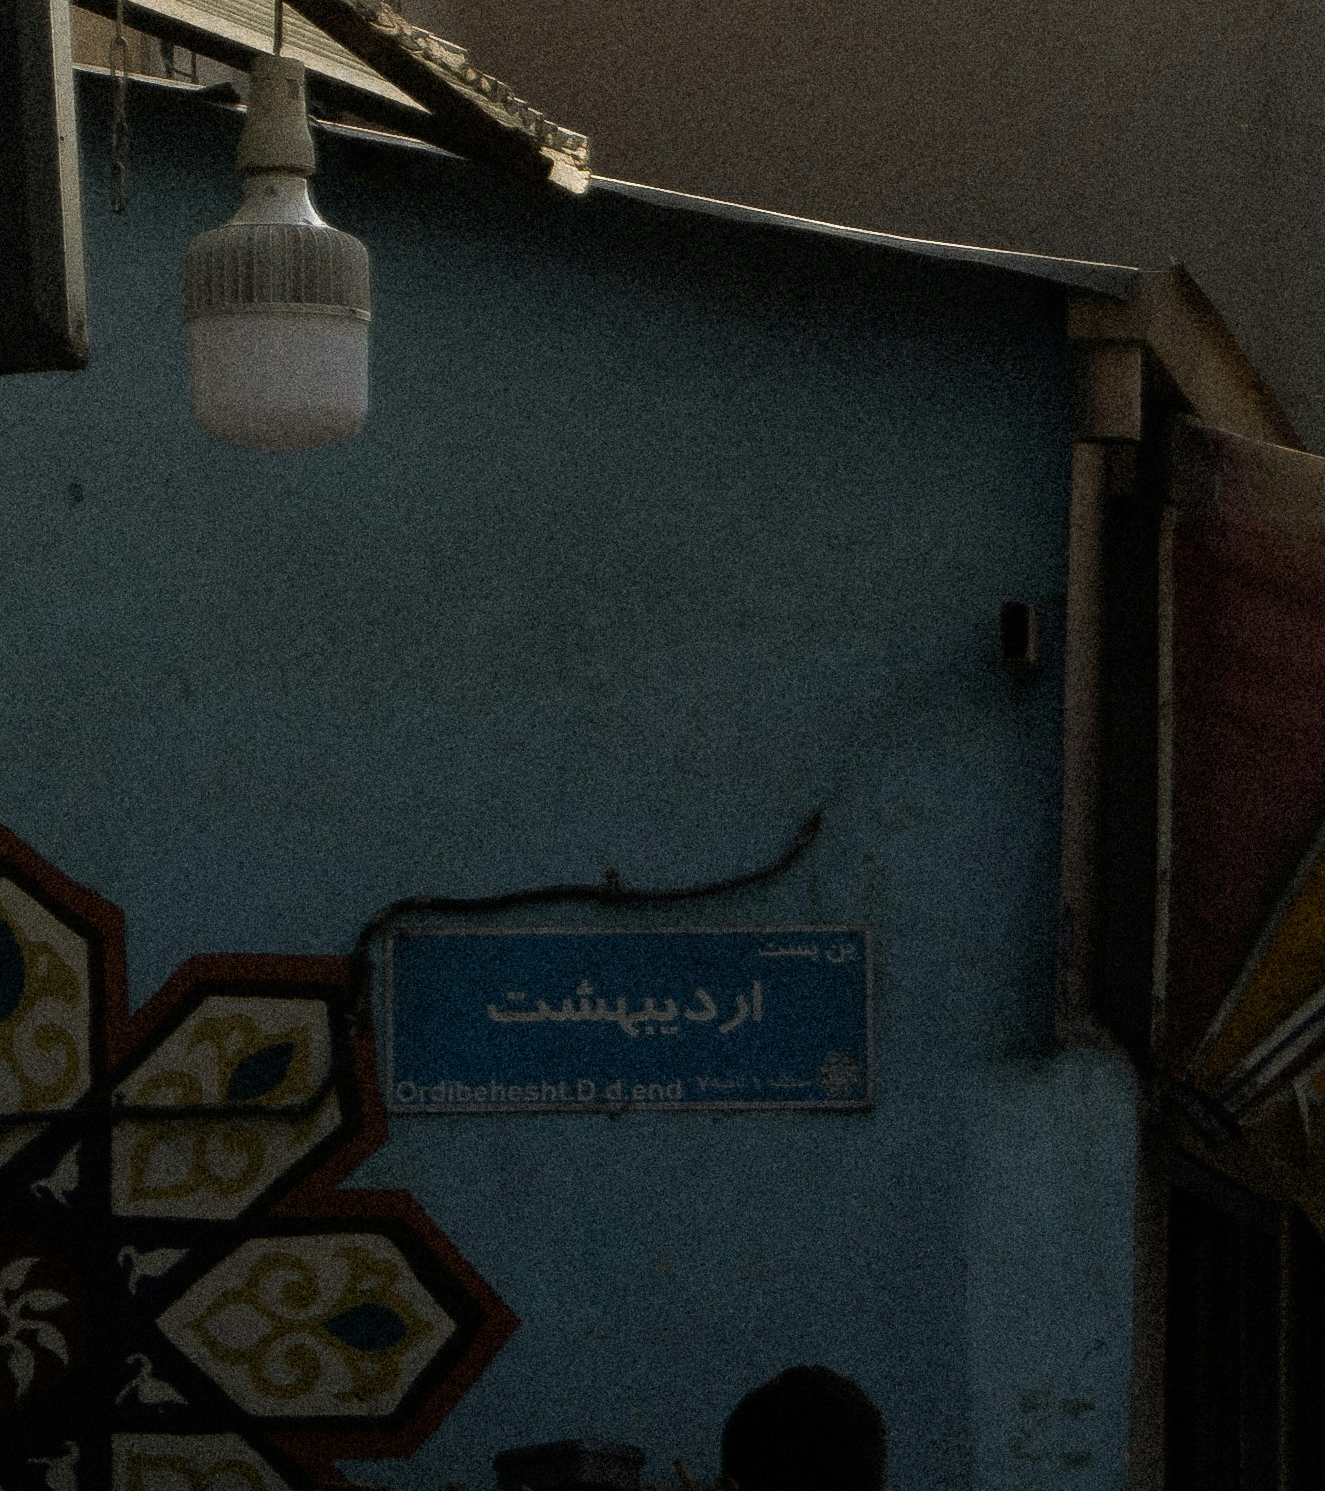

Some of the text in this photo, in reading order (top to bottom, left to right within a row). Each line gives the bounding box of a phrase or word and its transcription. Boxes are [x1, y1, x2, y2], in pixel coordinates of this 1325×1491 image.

[758, 941, 861, 964] بن بست
[486, 978, 765, 1037] اردیبهشت
